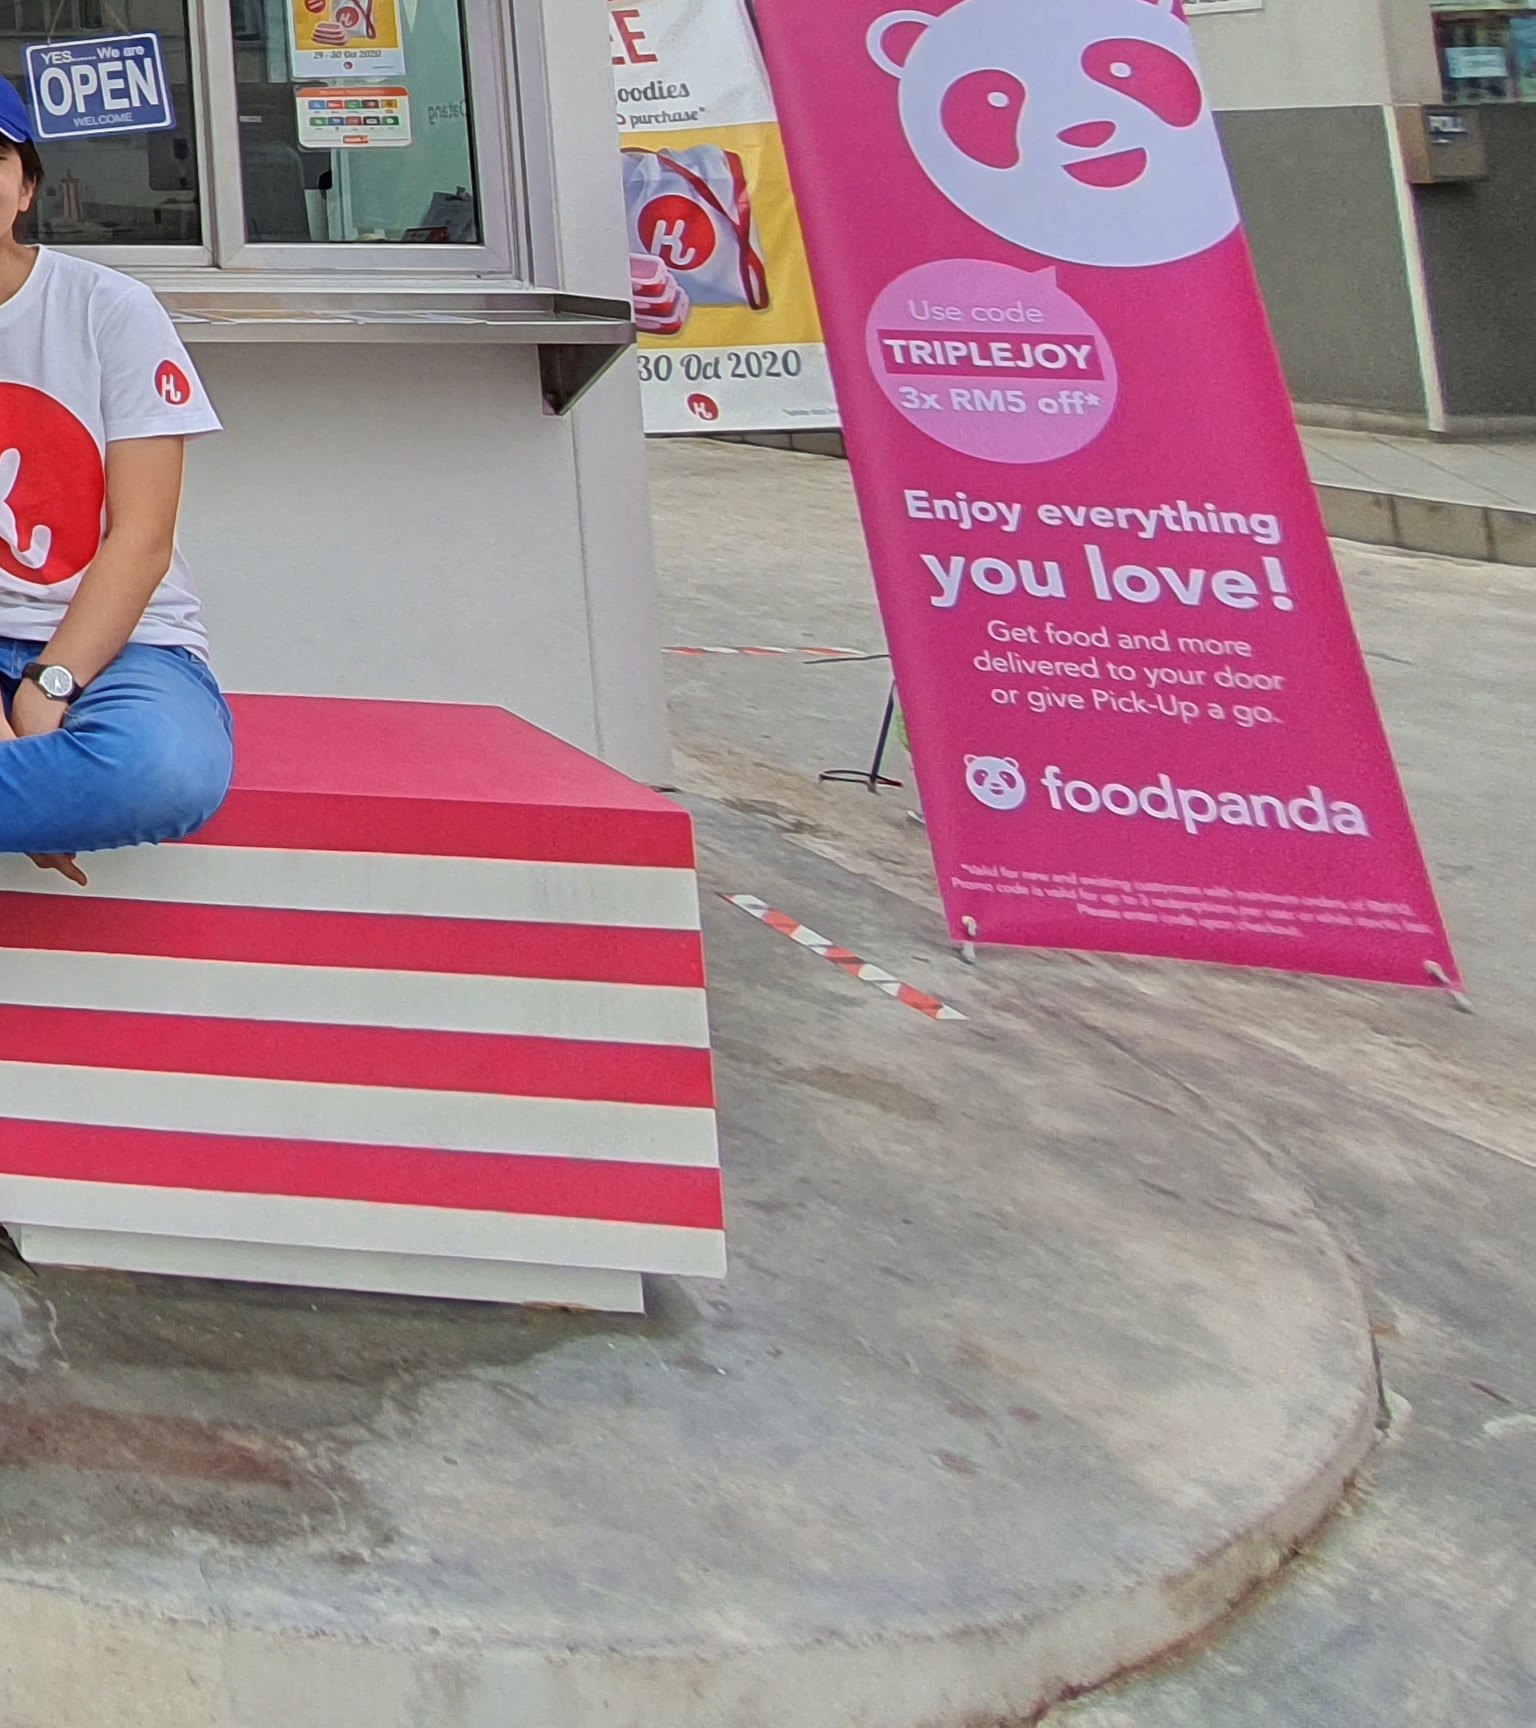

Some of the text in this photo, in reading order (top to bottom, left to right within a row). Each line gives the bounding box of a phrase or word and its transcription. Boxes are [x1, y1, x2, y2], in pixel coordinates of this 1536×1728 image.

[97, 46, 120, 59] We
[123, 45, 145, 57] are
[40, 58, 159, 116] OPEN
[617, 80, 690, 103] oodies
[73, 113, 134, 126] WELCOME
[908, 299, 1044, 323] Use code
[679, 353, 722, 380] Oct
[728, 349, 801, 378] 2020
[882, 338, 1092, 370] TRIPLEJOY
[898, 386, 944, 410] 3x
[949, 387, 1026, 413] RM5
[904, 489, 1281, 545] Enjoy everything
[919, 543, 1294, 612] you love!
[987, 619, 1253, 658] Get food and more
[973, 649, 1285, 692] delivered to your door
[991, 685, 1283, 729] or give Pick-Up a go.
[1040, 765, 1370, 838] foodpanda
